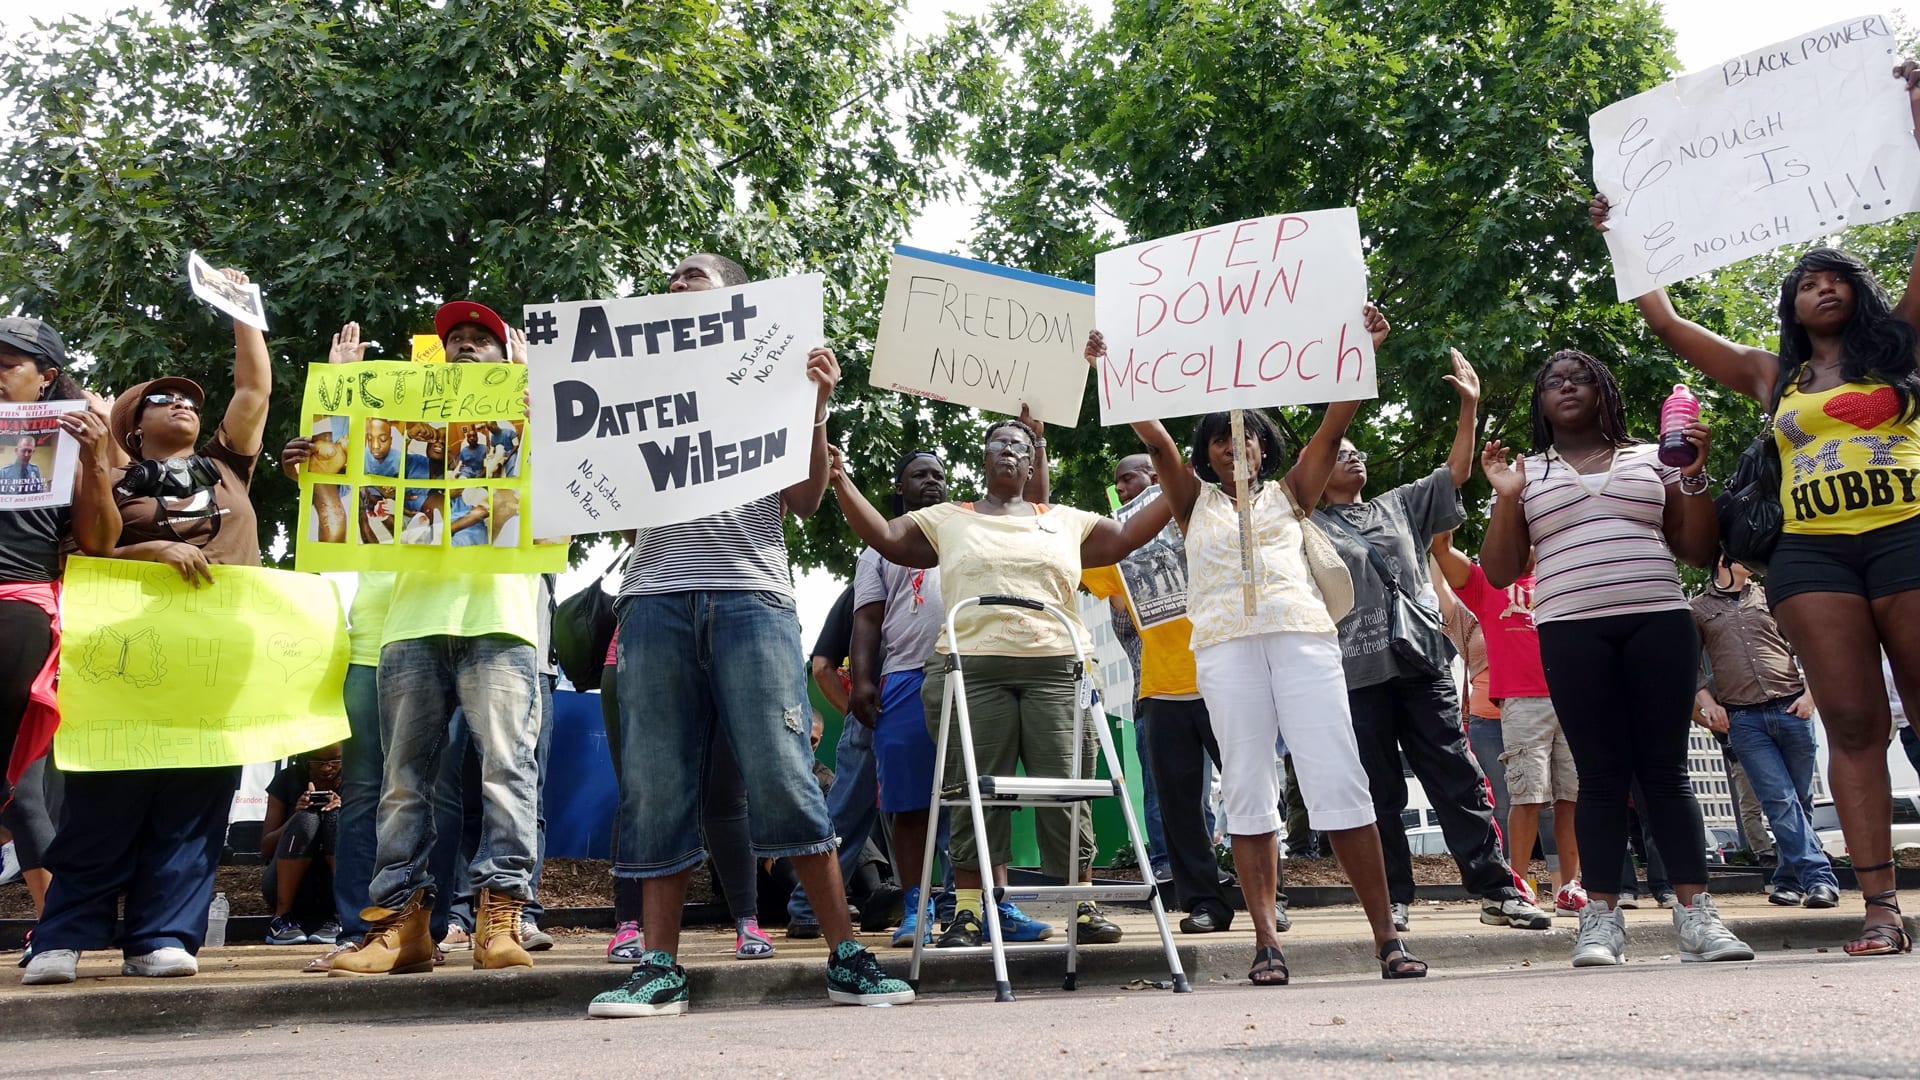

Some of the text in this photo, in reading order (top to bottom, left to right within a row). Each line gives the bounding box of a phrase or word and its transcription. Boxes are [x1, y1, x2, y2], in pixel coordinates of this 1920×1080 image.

[1722, 14, 1893, 88] BLACK POWER!
[1618, 111, 1785, 216] ENOUGH
[1744, 145, 1811, 192] IS
[1129, 216, 1309, 286] STEP
[1643, 215, 1791, 284] ENOUGH
[903, 276, 1075, 353] FREEDOM
[1136, 259, 1304, 337] DOWN
[930, 347, 1030, 400] NOW!
[422, 393, 528, 418] FERGUS
[1776, 409, 1817, 450] I
[577, 458, 593, 480] No
[1791, 435, 1910, 484] MY
[0, 484, 46, 492] USTICE
[566, 479, 581, 498] No
[1790, 468, 1920, 521] HUBBY
[64, 558, 306, 617] JUSIC
[1340, 617, 1363, 636] ecome
[1364, 607, 1389, 627] reality
[1362, 635, 1390, 656] dreams
[187, 637, 221, 687] 4
[235, 796, 262, 804] Brandon
